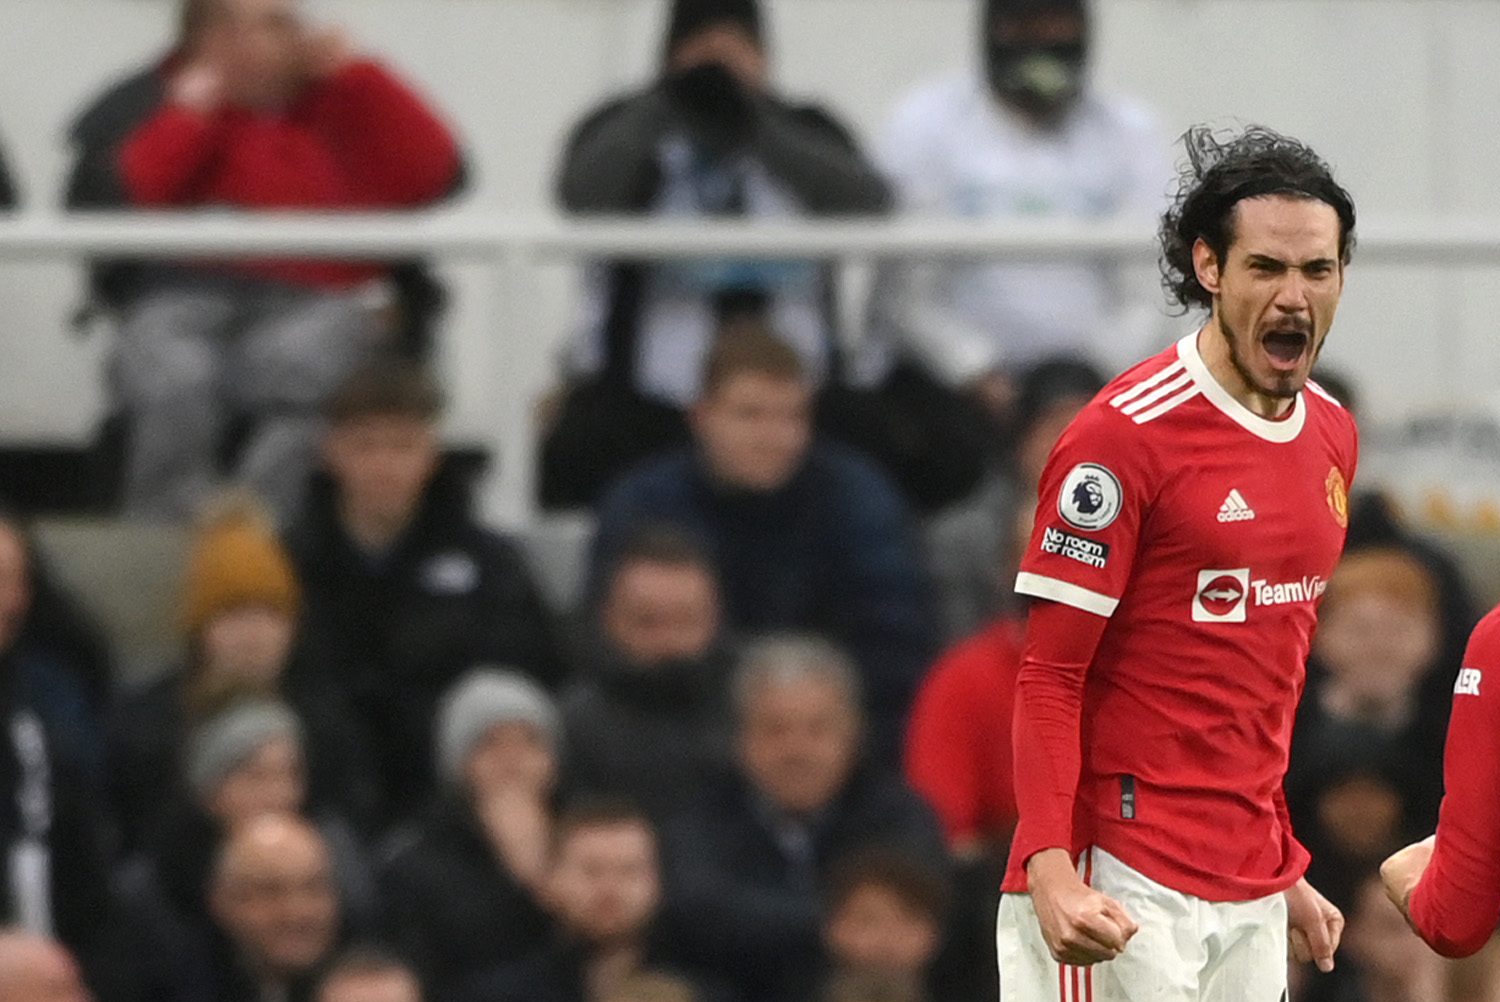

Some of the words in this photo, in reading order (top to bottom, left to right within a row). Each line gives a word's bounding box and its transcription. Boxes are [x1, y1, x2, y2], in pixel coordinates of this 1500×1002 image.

[1217, 508, 1256, 523] adidas
[1044, 526, 1064, 543] No
[1065, 535, 1103, 556] room
